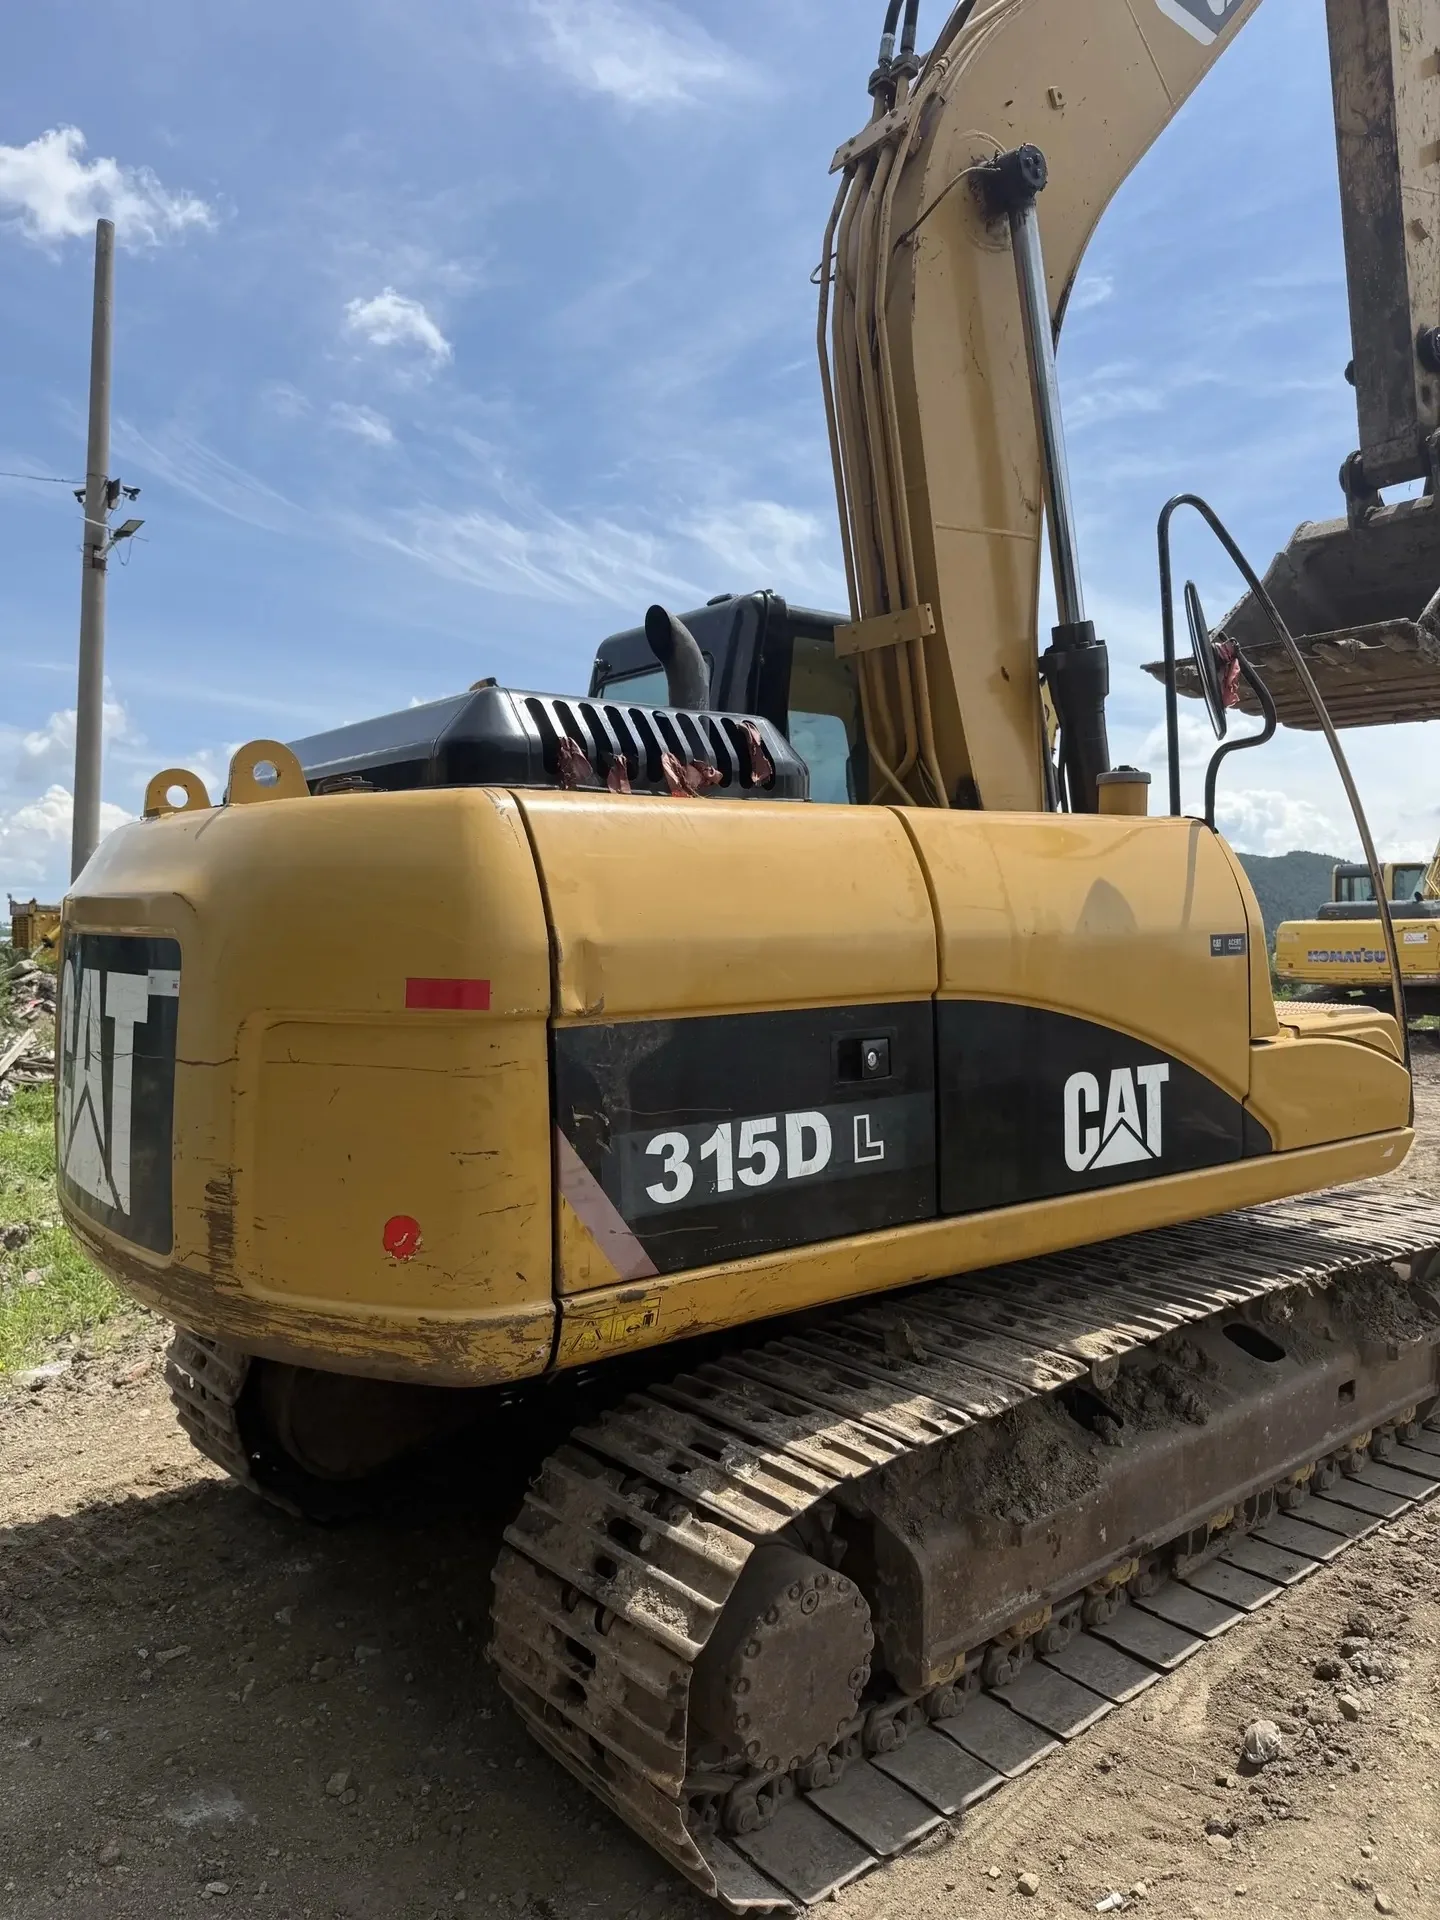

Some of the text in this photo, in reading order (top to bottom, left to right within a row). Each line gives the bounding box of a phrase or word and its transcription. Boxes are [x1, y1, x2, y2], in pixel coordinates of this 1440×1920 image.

[1308, 947, 1386, 963] KOMATSU
[644, 1110, 885, 1204] 315D L
[1064, 1062, 1170, 1172] CAT
